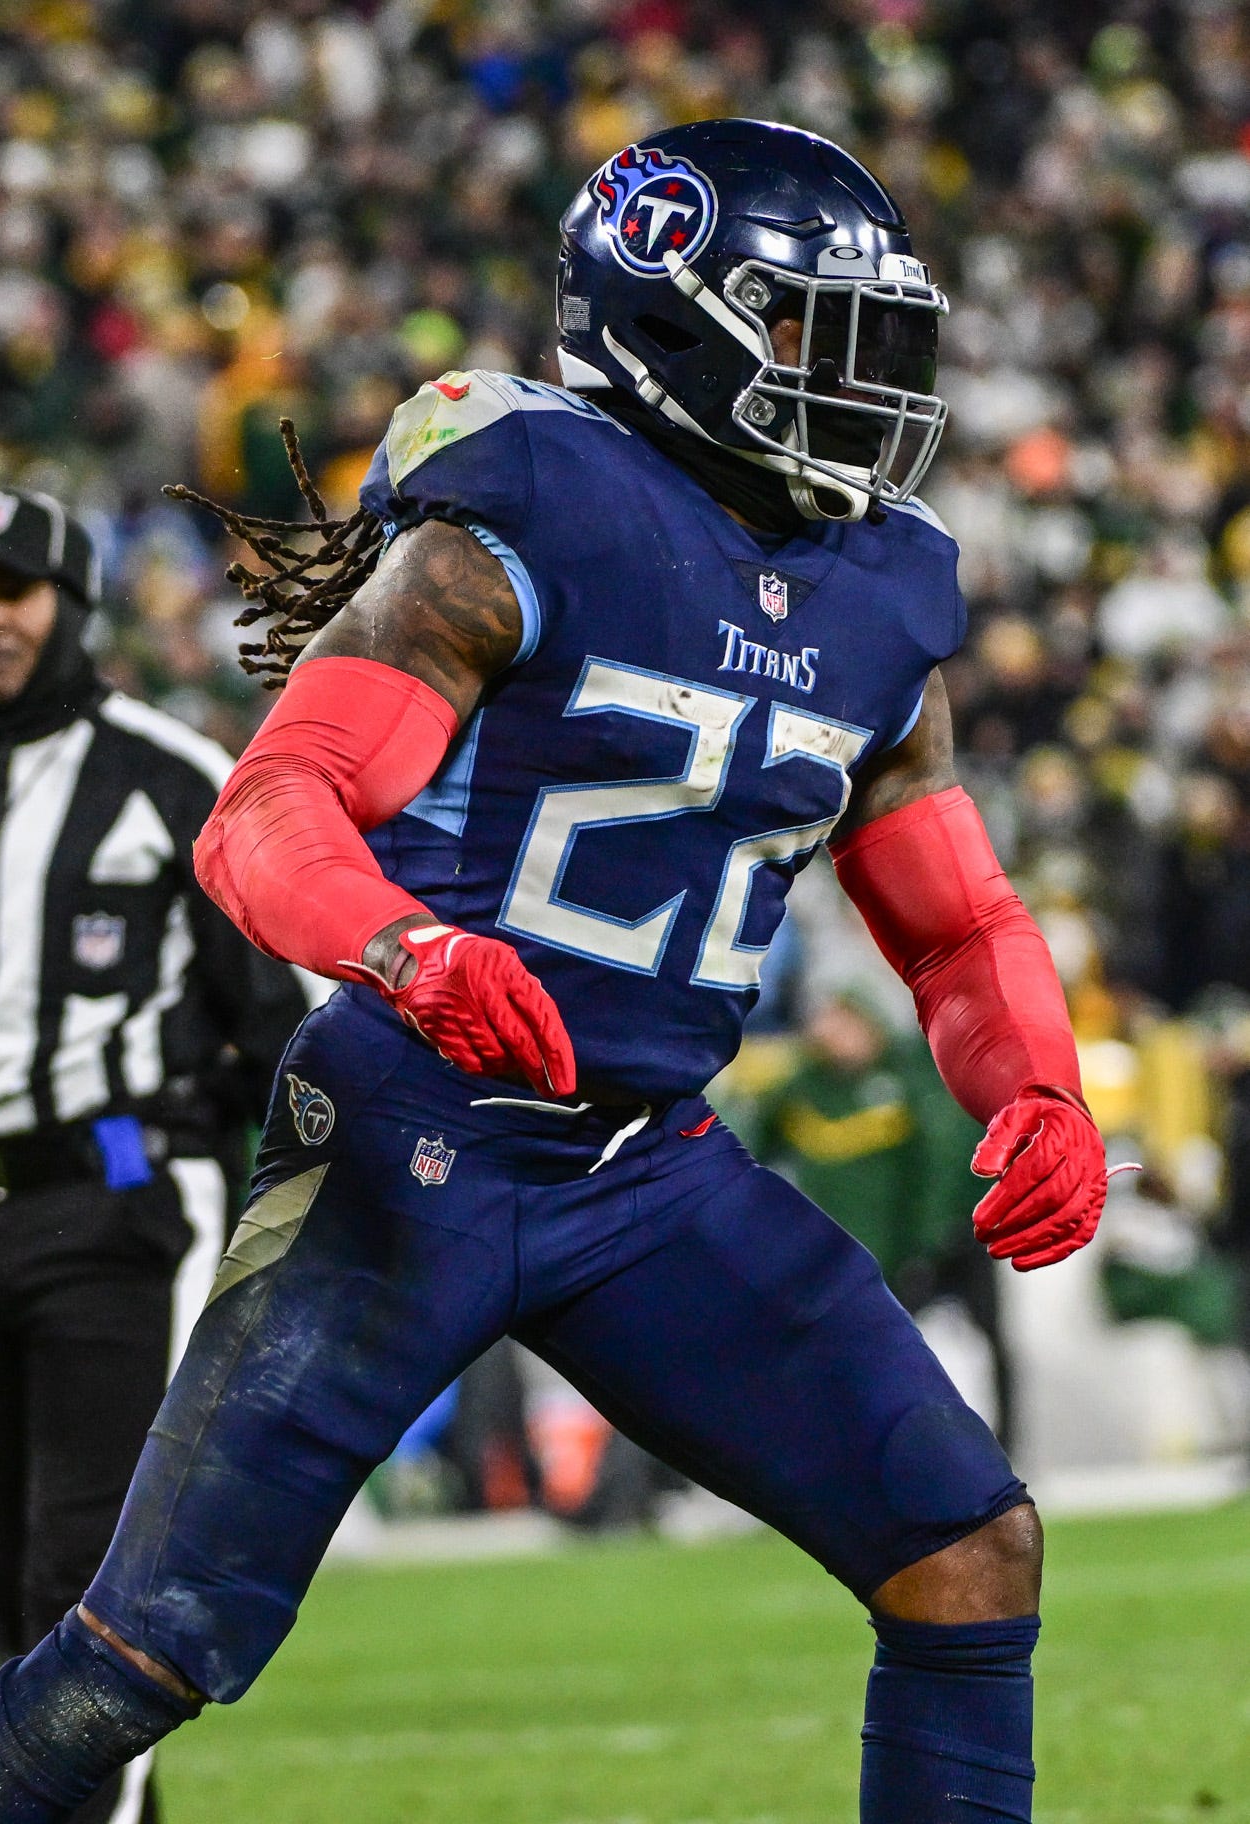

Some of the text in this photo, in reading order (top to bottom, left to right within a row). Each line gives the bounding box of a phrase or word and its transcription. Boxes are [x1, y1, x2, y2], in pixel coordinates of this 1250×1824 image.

[765, 592, 785, 613] NFL
[716, 619, 820, 694] TITANS
[495, 654, 875, 992] 22
[416, 1156, 441, 1178] NFL
